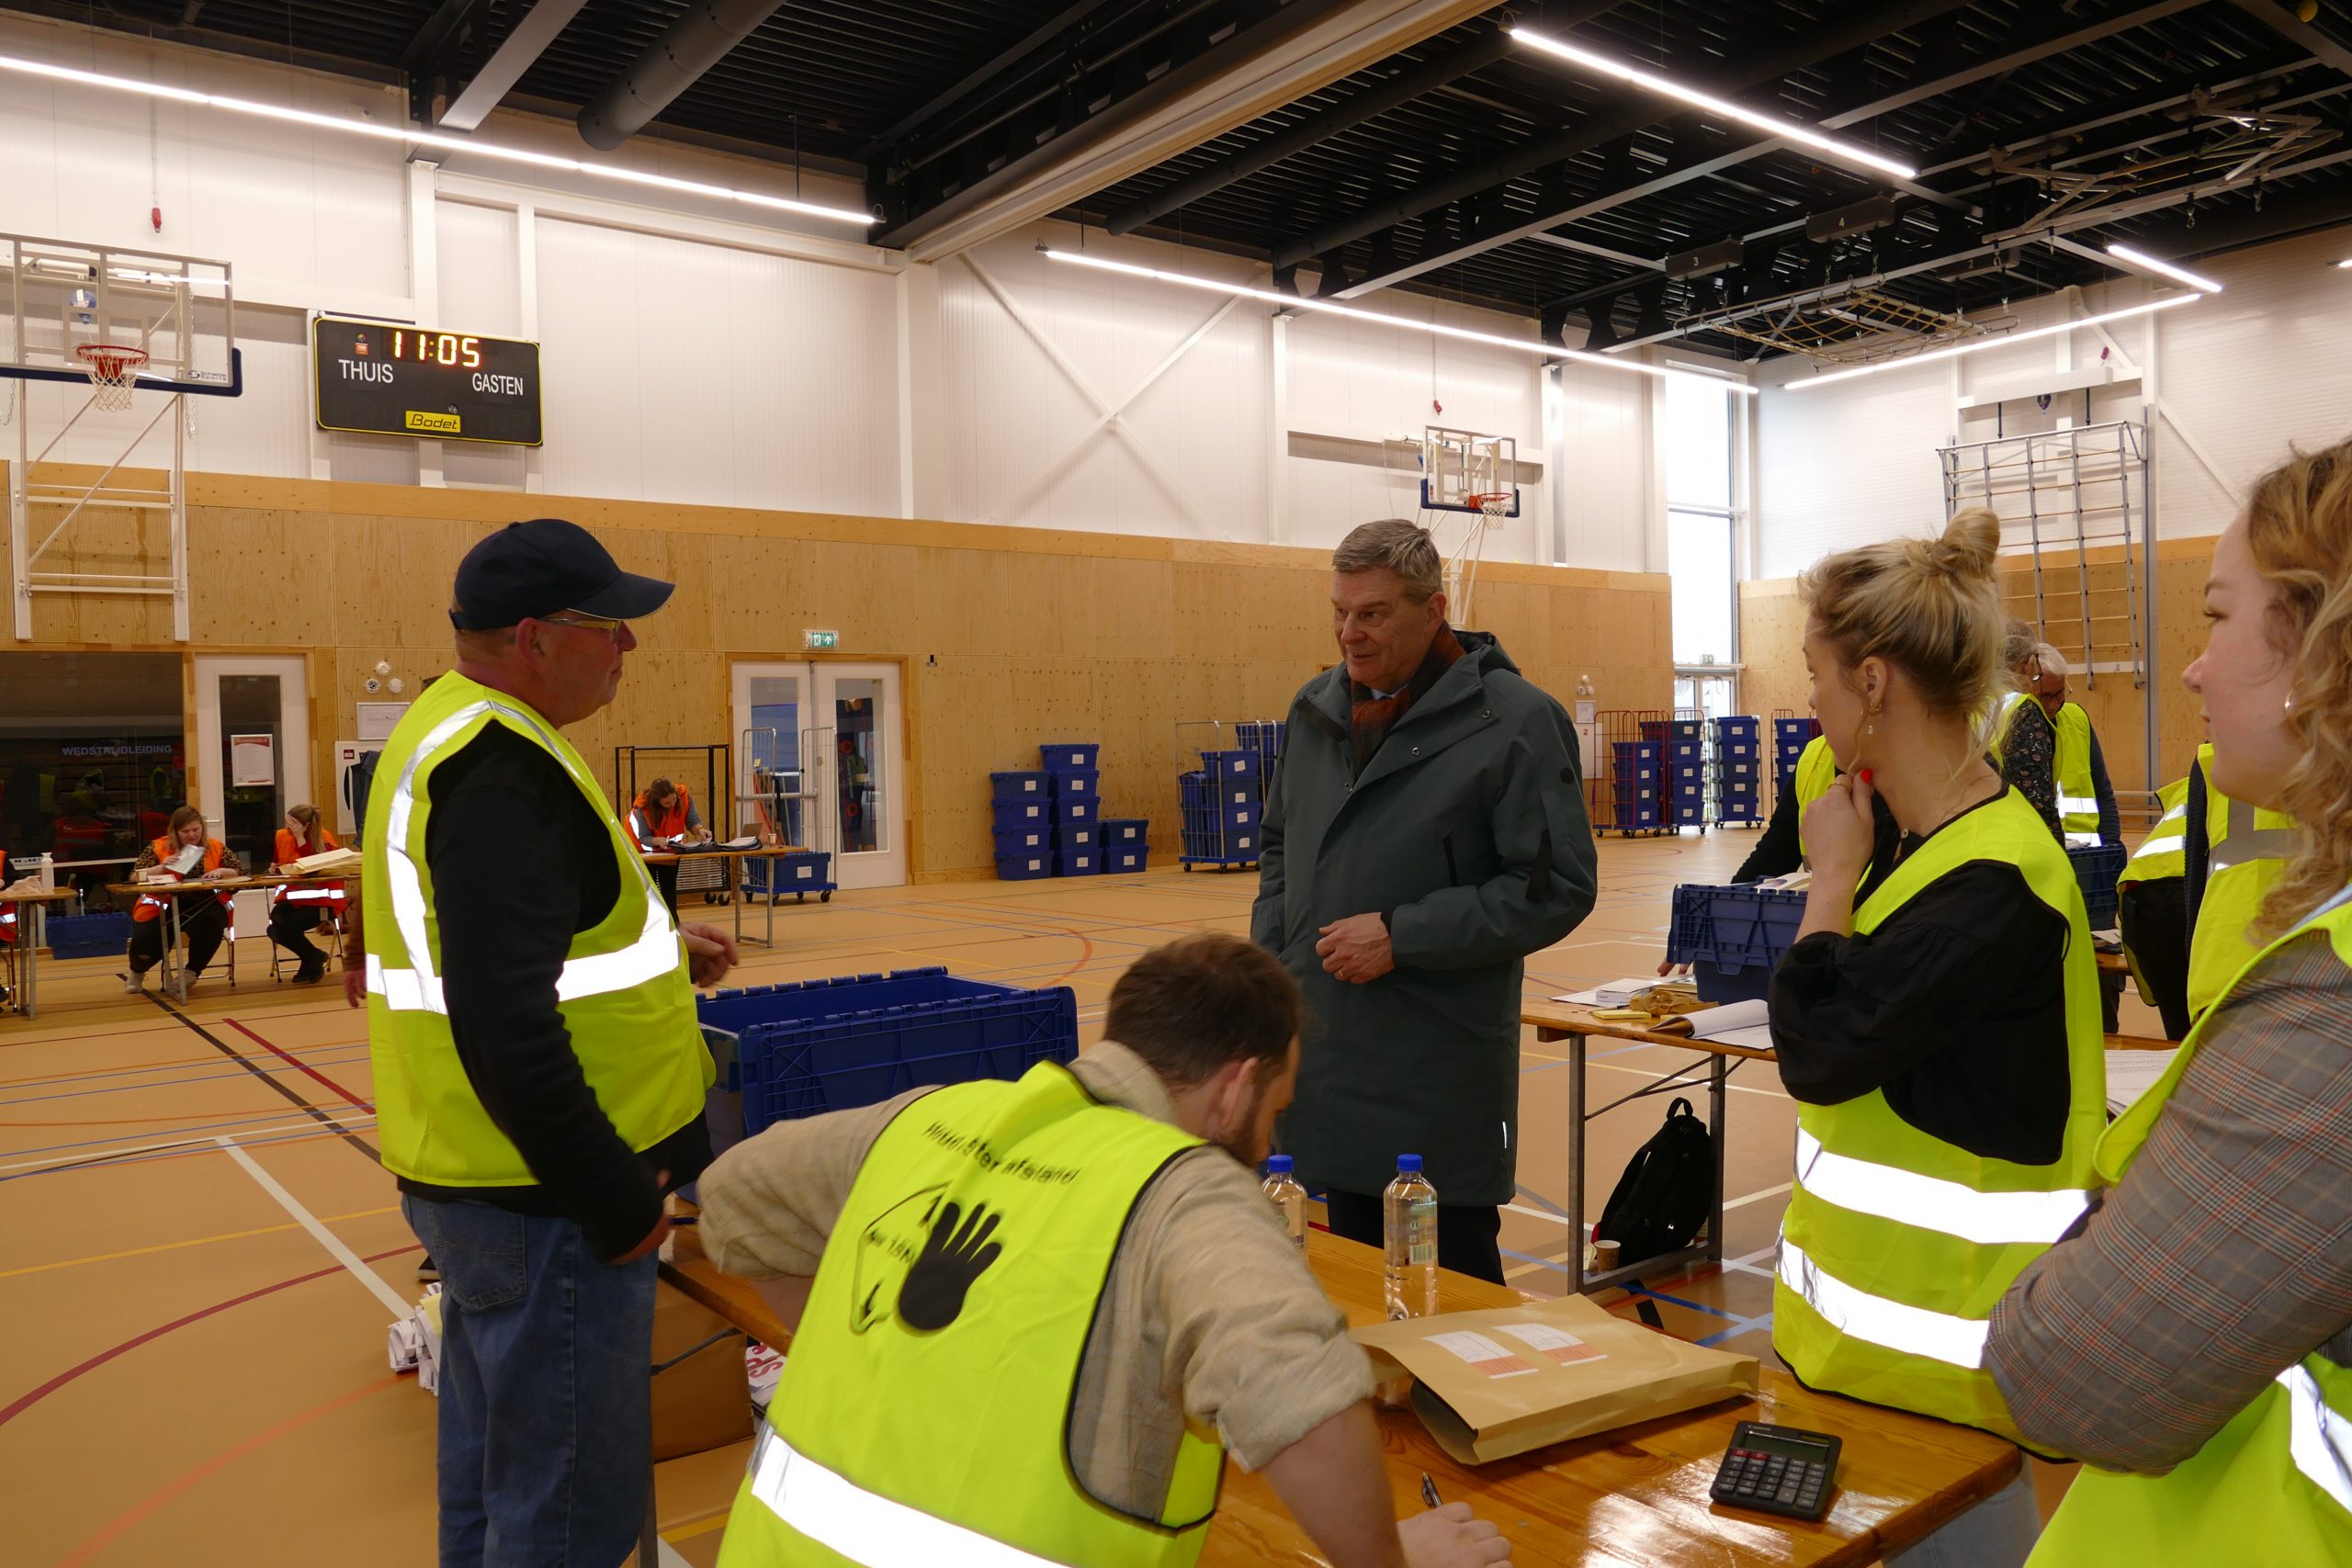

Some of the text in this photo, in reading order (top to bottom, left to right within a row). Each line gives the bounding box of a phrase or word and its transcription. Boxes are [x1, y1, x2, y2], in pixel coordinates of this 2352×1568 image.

[393, 331, 481, 367] 11:05
[338, 359, 394, 384] THUIS
[472, 372, 524, 396] GASTEN
[409, 413, 458, 430] Bodet
